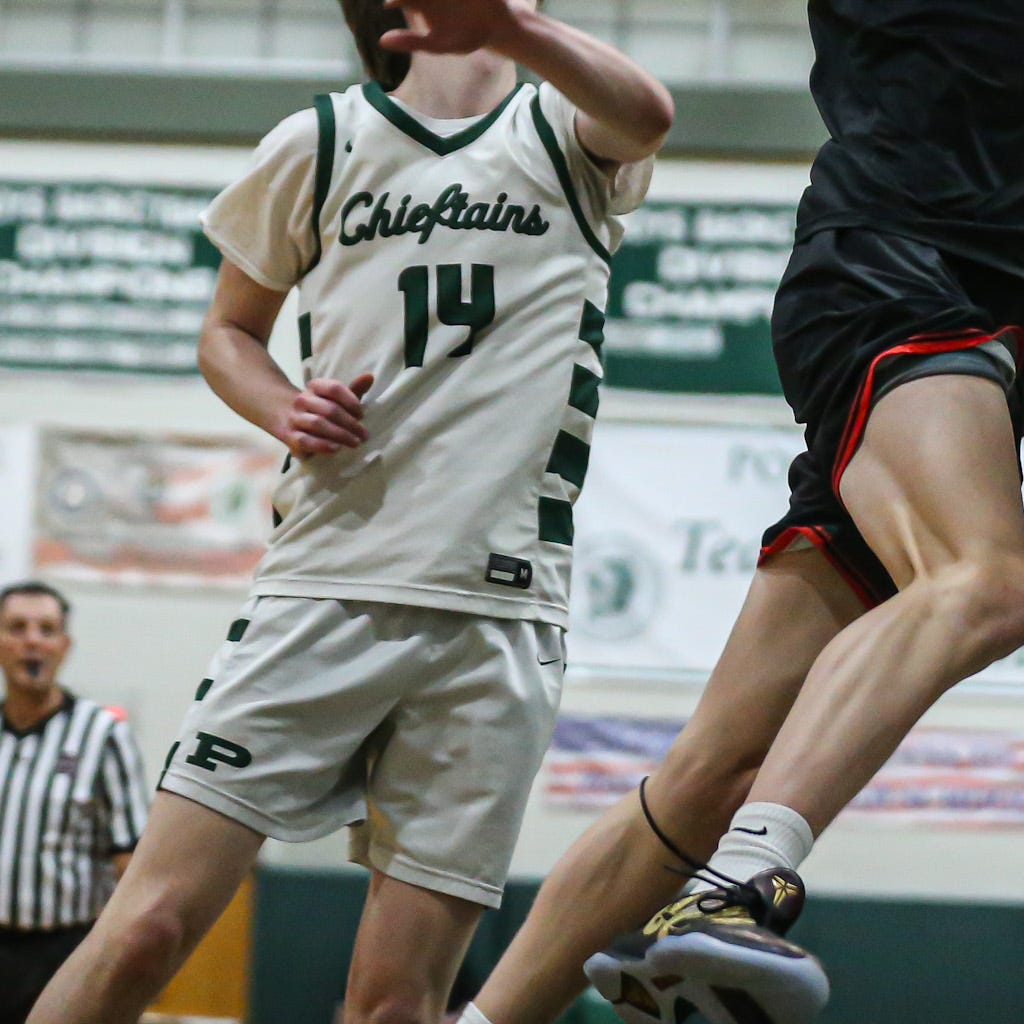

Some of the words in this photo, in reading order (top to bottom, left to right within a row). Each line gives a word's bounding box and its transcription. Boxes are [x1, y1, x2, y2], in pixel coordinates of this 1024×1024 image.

[338, 182, 550, 247] Chieftains
[398, 263, 496, 369] 14
[185, 731, 252, 772] P
